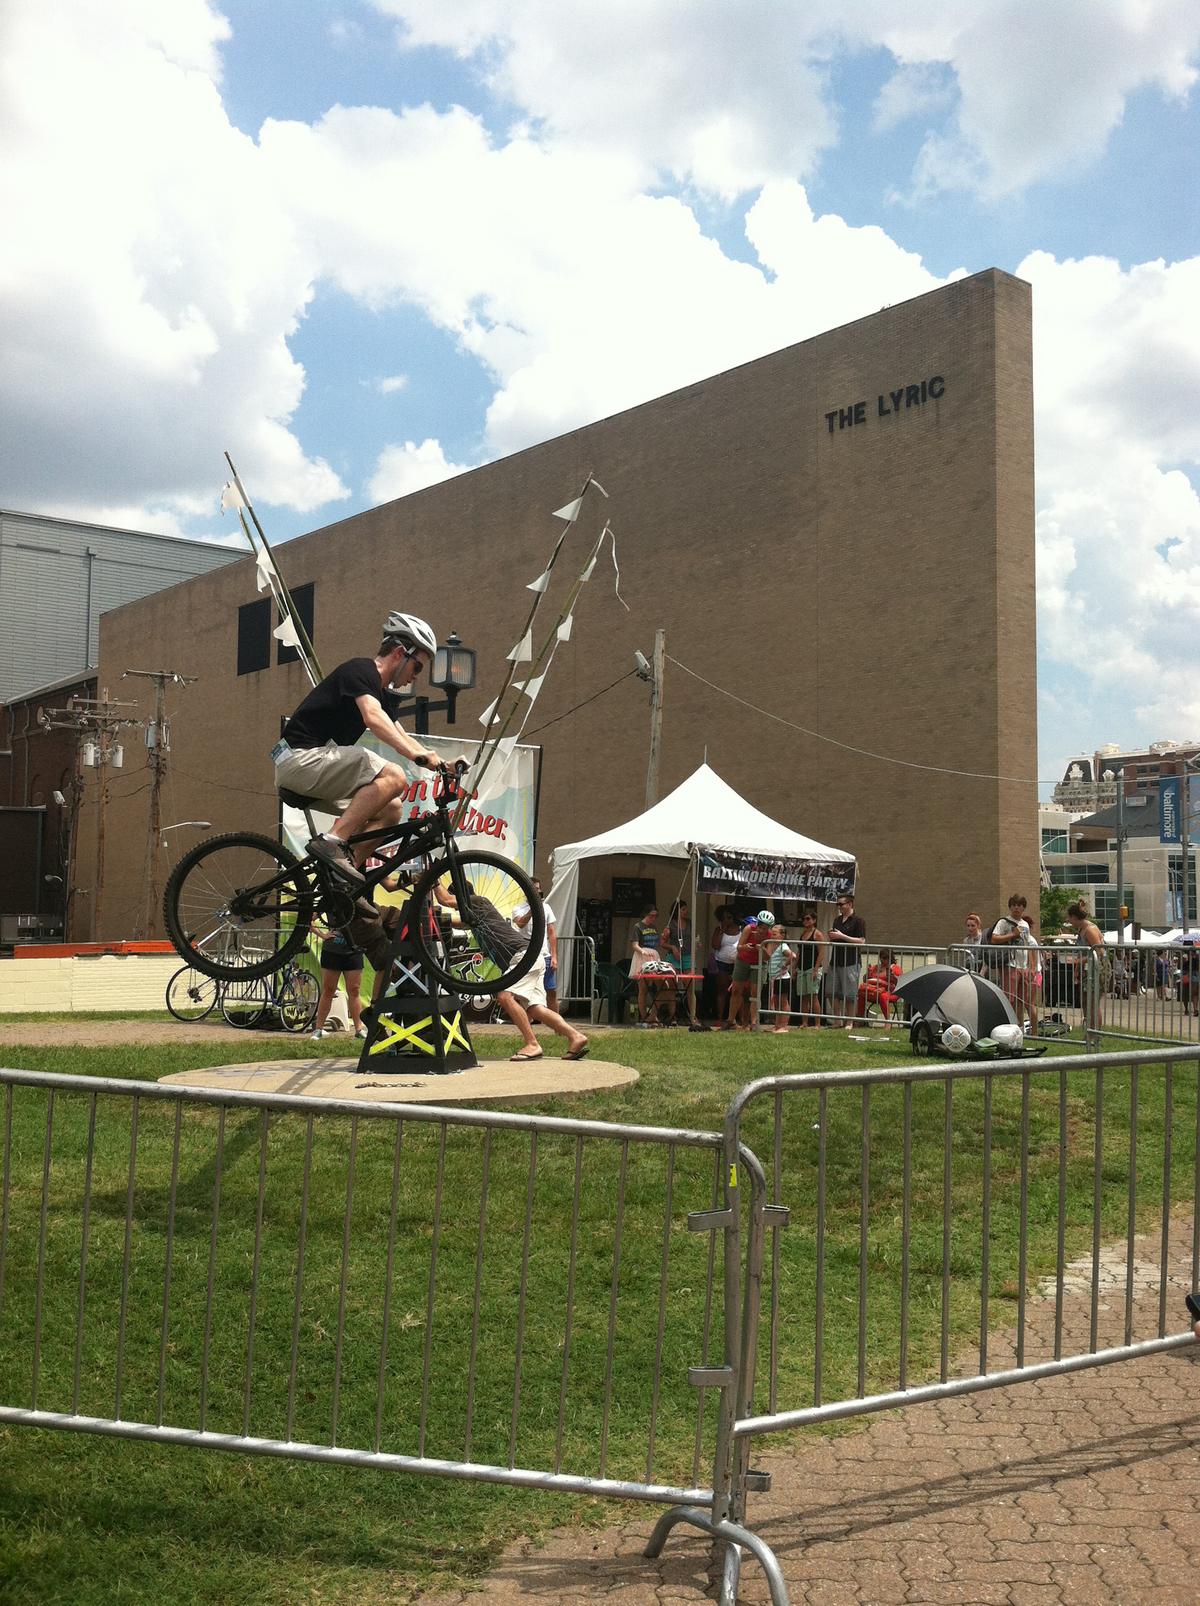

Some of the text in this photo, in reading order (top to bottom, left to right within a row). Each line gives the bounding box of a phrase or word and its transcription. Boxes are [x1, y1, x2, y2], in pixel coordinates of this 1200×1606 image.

[825, 376, 945, 433] THE LYRIC
[409, 805, 508, 841] tother.
[1163, 792, 1175, 838] baltimore
[702, 865, 849, 890] BALTIMORE BIKE PARTY
